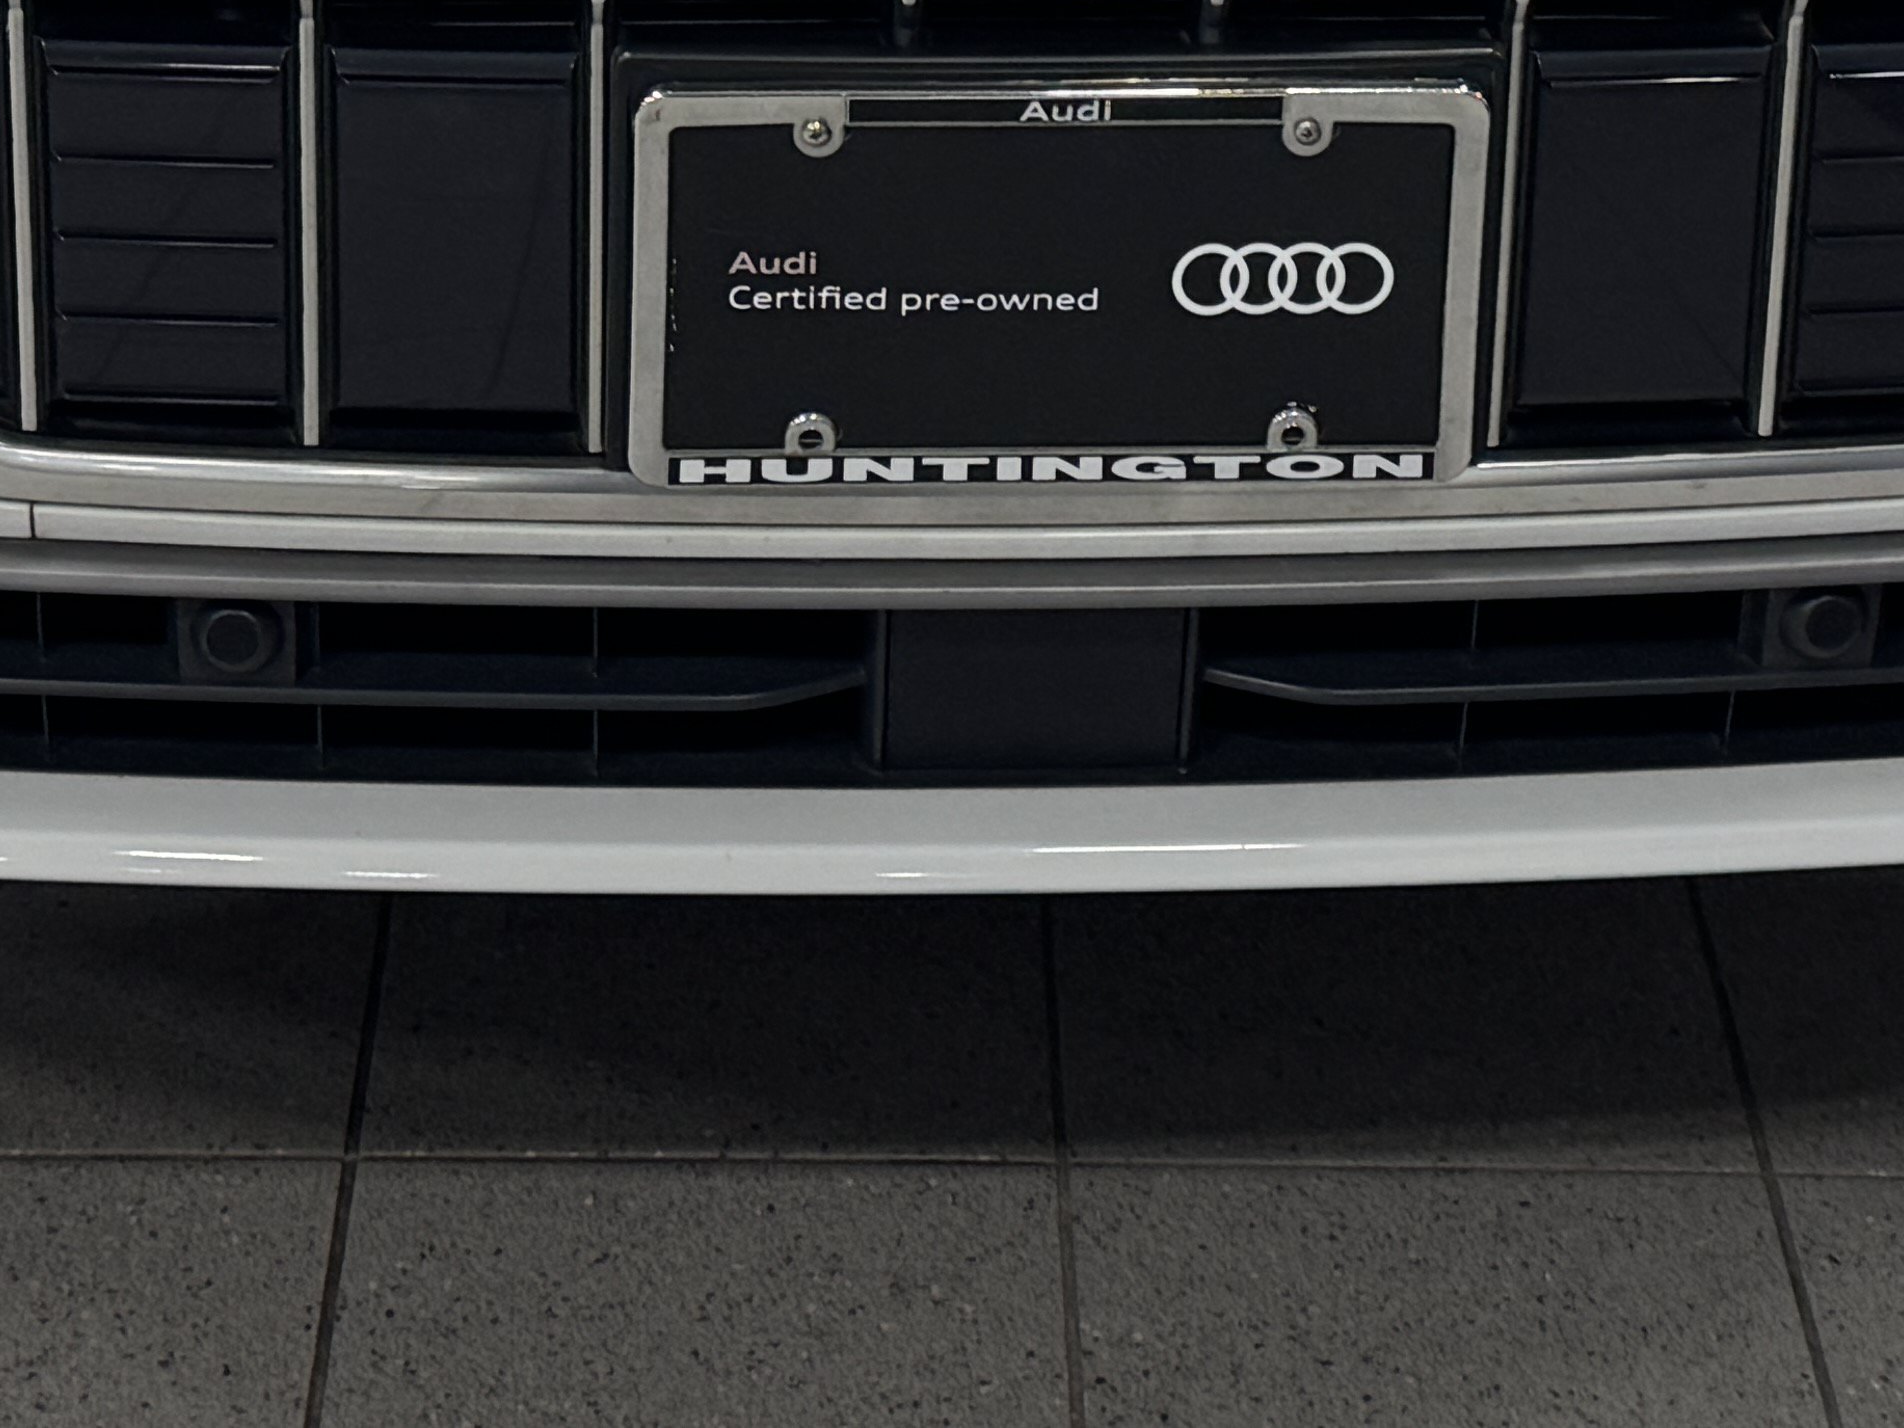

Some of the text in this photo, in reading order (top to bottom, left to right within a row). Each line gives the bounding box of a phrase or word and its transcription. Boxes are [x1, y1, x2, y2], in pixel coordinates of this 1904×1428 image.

[1019, 99, 1113, 123] Audi
[727, 250, 818, 276] Audi
[727, 285, 1100, 317] Certified pre-owned
[677, 453, 1425, 484] HUNTINGTON
